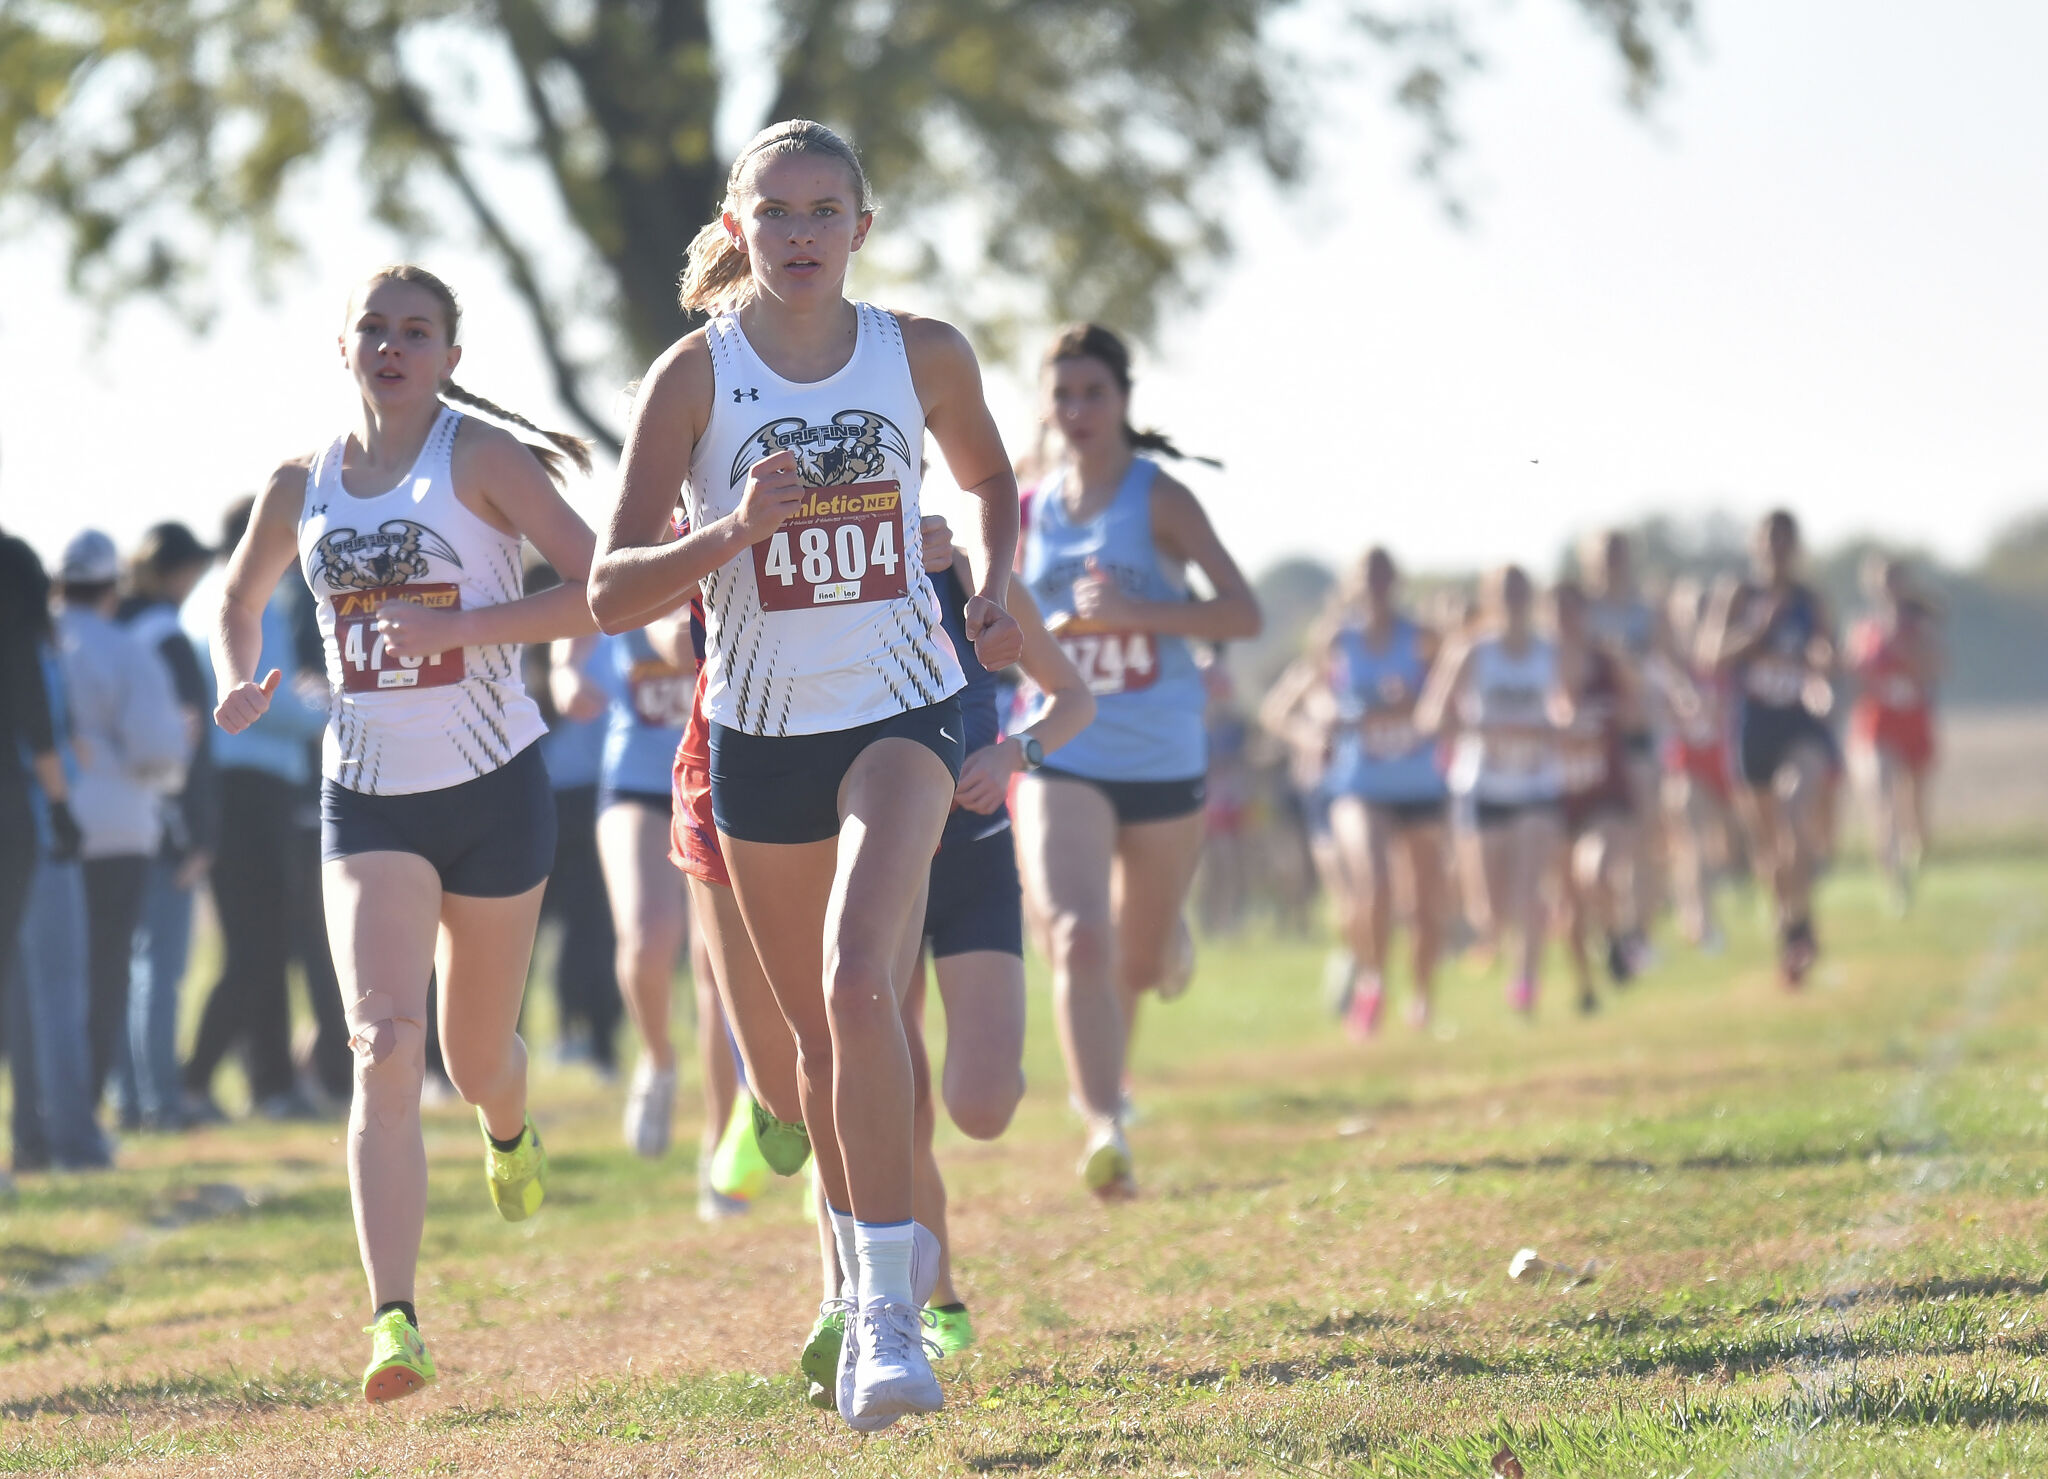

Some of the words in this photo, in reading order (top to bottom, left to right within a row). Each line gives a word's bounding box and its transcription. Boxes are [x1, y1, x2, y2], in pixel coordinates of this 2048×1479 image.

[777, 425, 862, 447] GRIFFINS
[782, 493, 861, 519] hletic
[867, 496, 895, 508] NET
[333, 532, 404, 554] GRIFFINS
[765, 521, 899, 586] 4804
[426, 596, 453, 606] NET
[345, 623, 443, 672] 47
